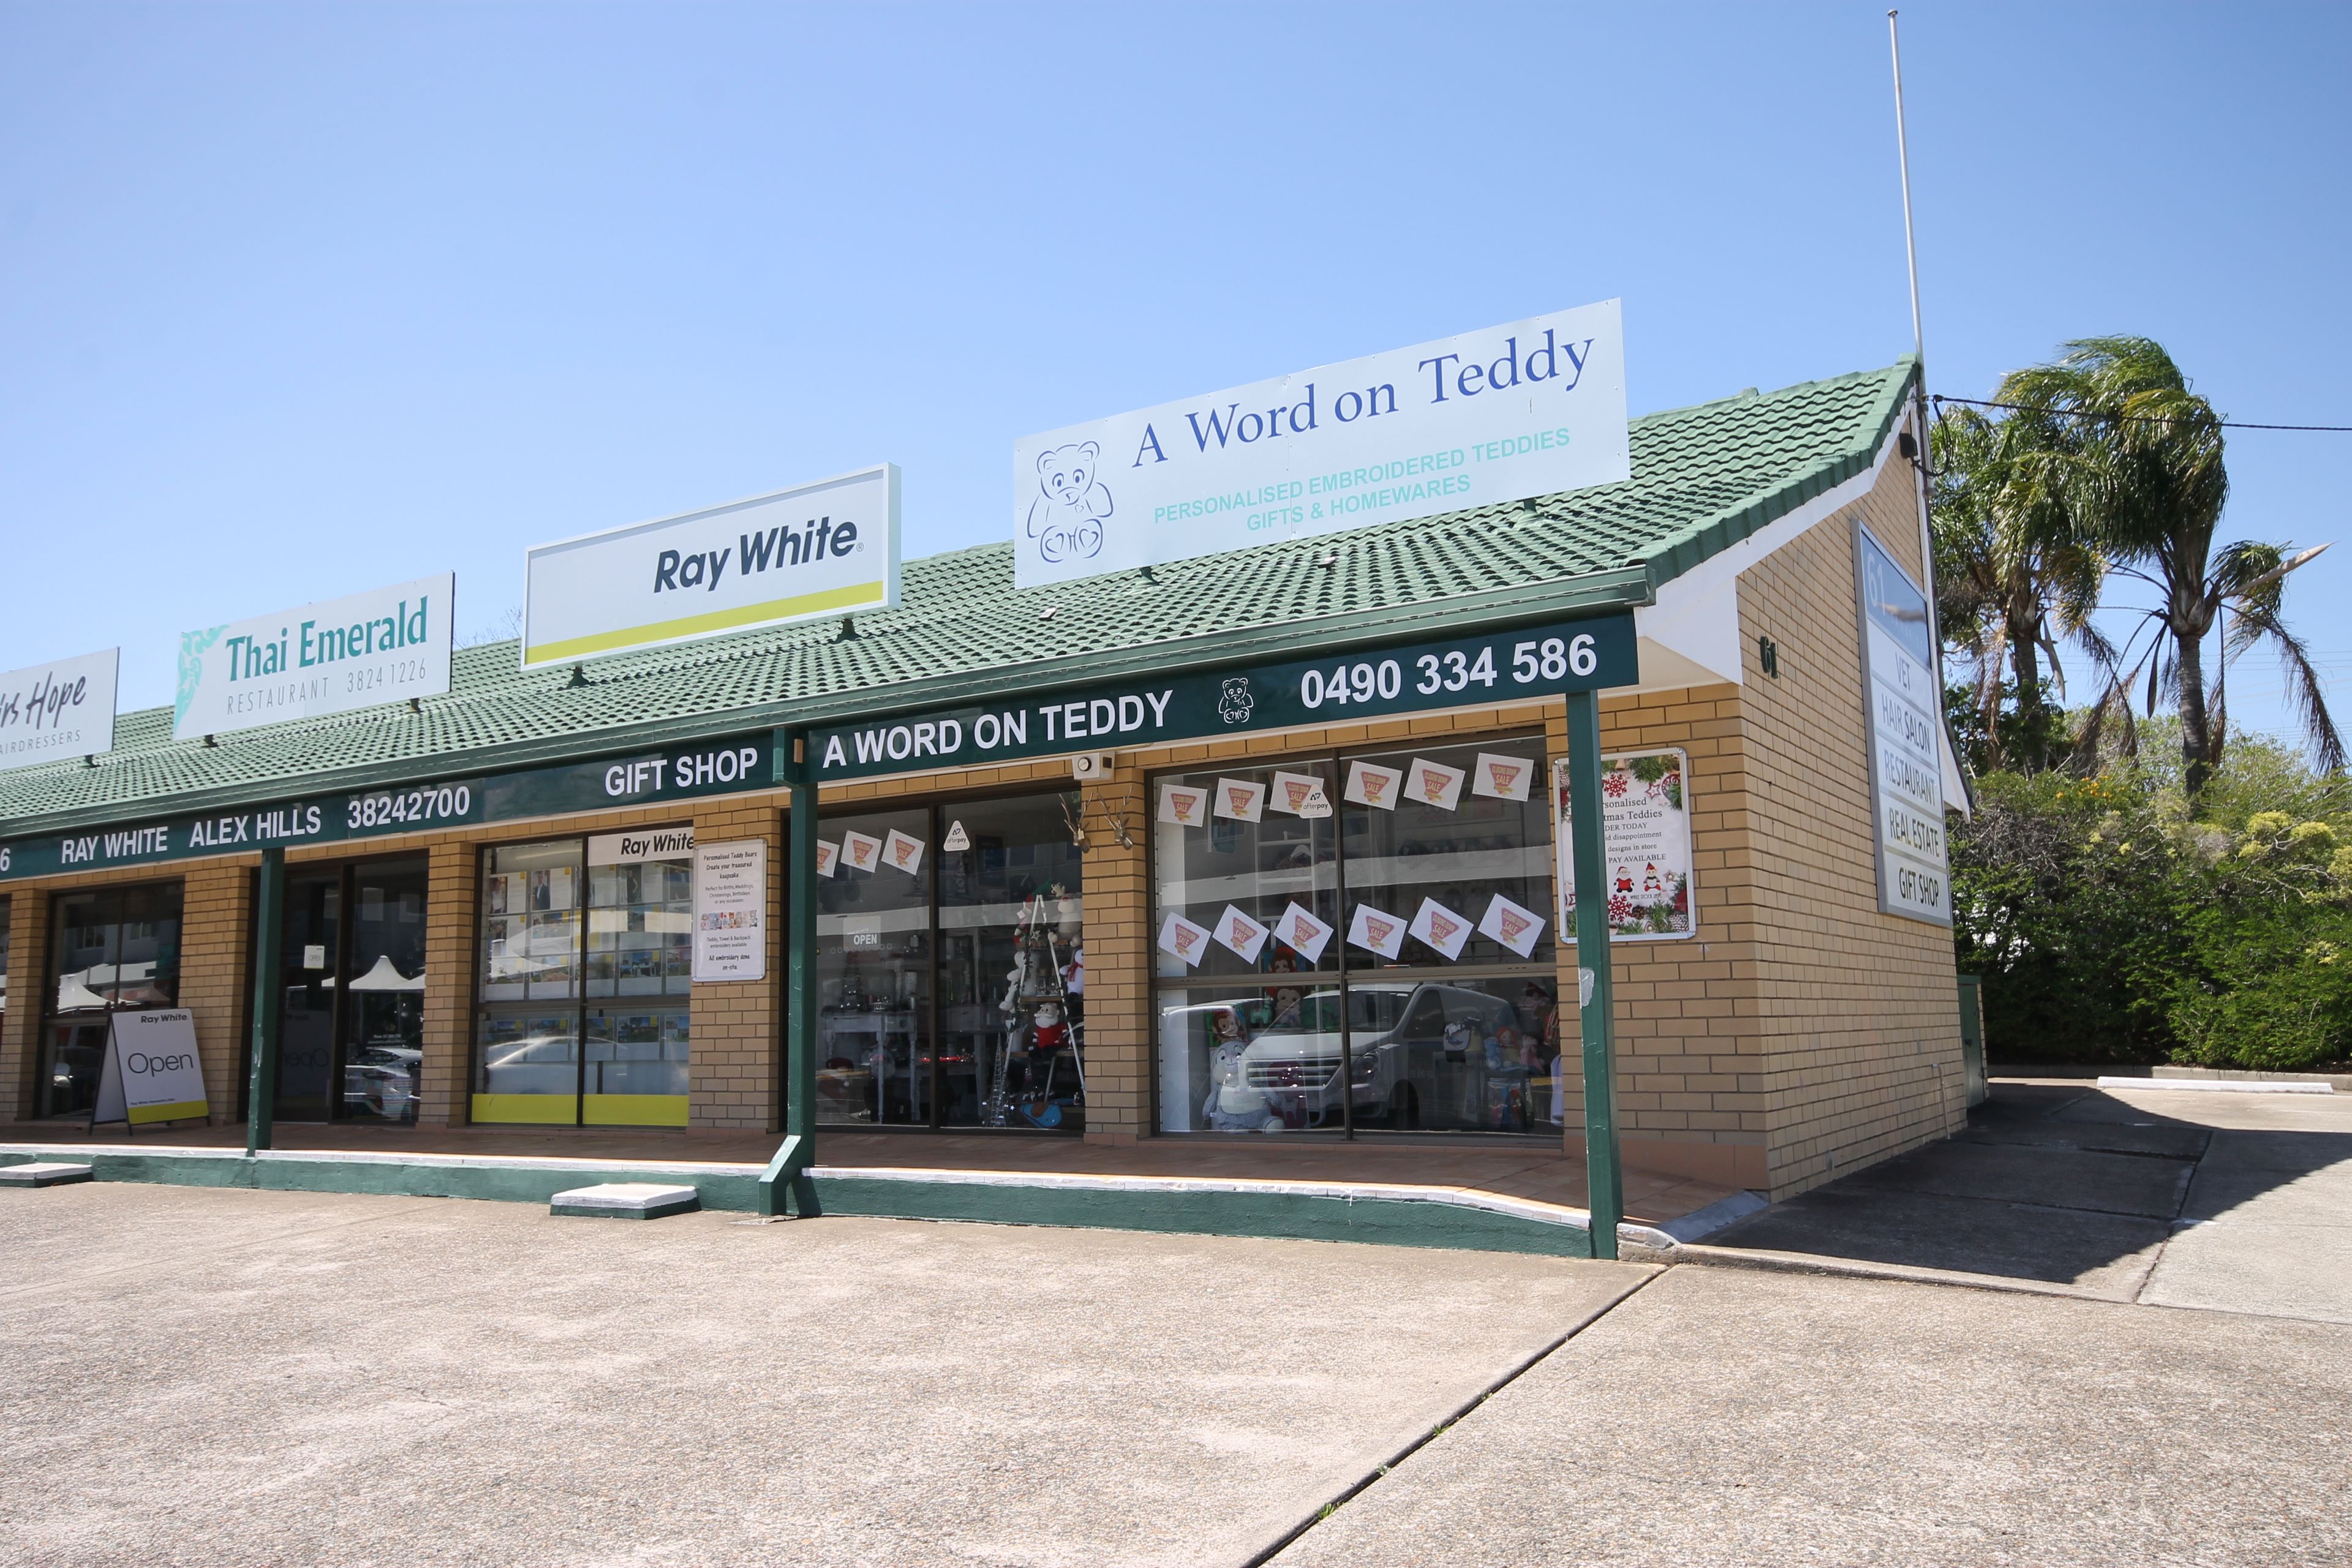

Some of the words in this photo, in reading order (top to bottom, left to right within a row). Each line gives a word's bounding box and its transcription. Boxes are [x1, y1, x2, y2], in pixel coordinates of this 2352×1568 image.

[1132, 423, 1168, 468] A
[1184, 382, 1318, 453] Word
[1334, 382, 1399, 423] on
[1418, 327, 1595, 405] Teddy
[1154, 482, 1303, 524] PERSONALISED
[1309, 448, 1465, 496] EMBROIDERED
[1472, 427, 1570, 464] TEDDIES
[1246, 504, 1306, 532] GIFTS
[1310, 500, 1324, 520] &
[1330, 473, 1471, 517] HOMEWARES
[654, 548, 732, 594] Ray
[739, 516, 858, 576] White
[1868, 552, 1885, 616] 61
[226, 627, 287, 682] Thai
[298, 595, 428, 668] Emerald
[1300, 660, 1401, 709] 0490
[1416, 646, 1497, 695] 334
[1512, 634, 1597, 684] 586
[1895, 652, 1910, 691] VET
[26, 671, 86, 729] Hope
[227, 677, 329, 715] RESTAURANT
[822, 735, 847, 769] A
[854, 720, 962, 764] WORD
[974, 710, 1027, 750] ON
[1039, 690, 1174, 741] TEDDY
[1882, 693, 1904, 736] HAIR
[1904, 710, 1931, 755] SALON
[605, 759, 668, 796] GIFT
[676, 747, 758, 788] SHOP
[1496, 774, 1509, 785] SALE
[1884, 748, 1935, 807] RESTAURANT
[1291, 792, 1303, 801] SALE
[1366, 783, 1379, 792] SALE
[1427, 781, 1440, 792] SALE
[1177, 804, 1188, 812] SALE
[1234, 798, 1245, 807] SALE
[1603, 797, 1647, 809] sonalised
[1627, 809, 1662, 820] Teddies
[62, 839, 96, 864] RAY
[104, 826, 168, 858] WHITE
[189, 815, 248, 848] ALEX
[255, 805, 321, 840] HILLS
[347, 785, 470, 830] 38242700
[1613, 832, 1662, 840] disappointment
[1889, 807, 1911, 845] REAL
[1912, 818, 1939, 858] ESTATE
[621, 837, 650, 857] Ray
[1899, 867, 1917, 902] GIFT
[1918, 873, 1939, 907] SHOP
[853, 933, 877, 945] OPEN
[1234, 930, 1247, 941] SALE
[1295, 928, 1308, 940] SALE
[1370, 929, 1384, 940] SALE
[1433, 925, 1446, 938] SALE
[1503, 922, 1518, 934] SALE
[1177, 935, 1189, 946] SALE
[128, 1053, 194, 1077] Open
